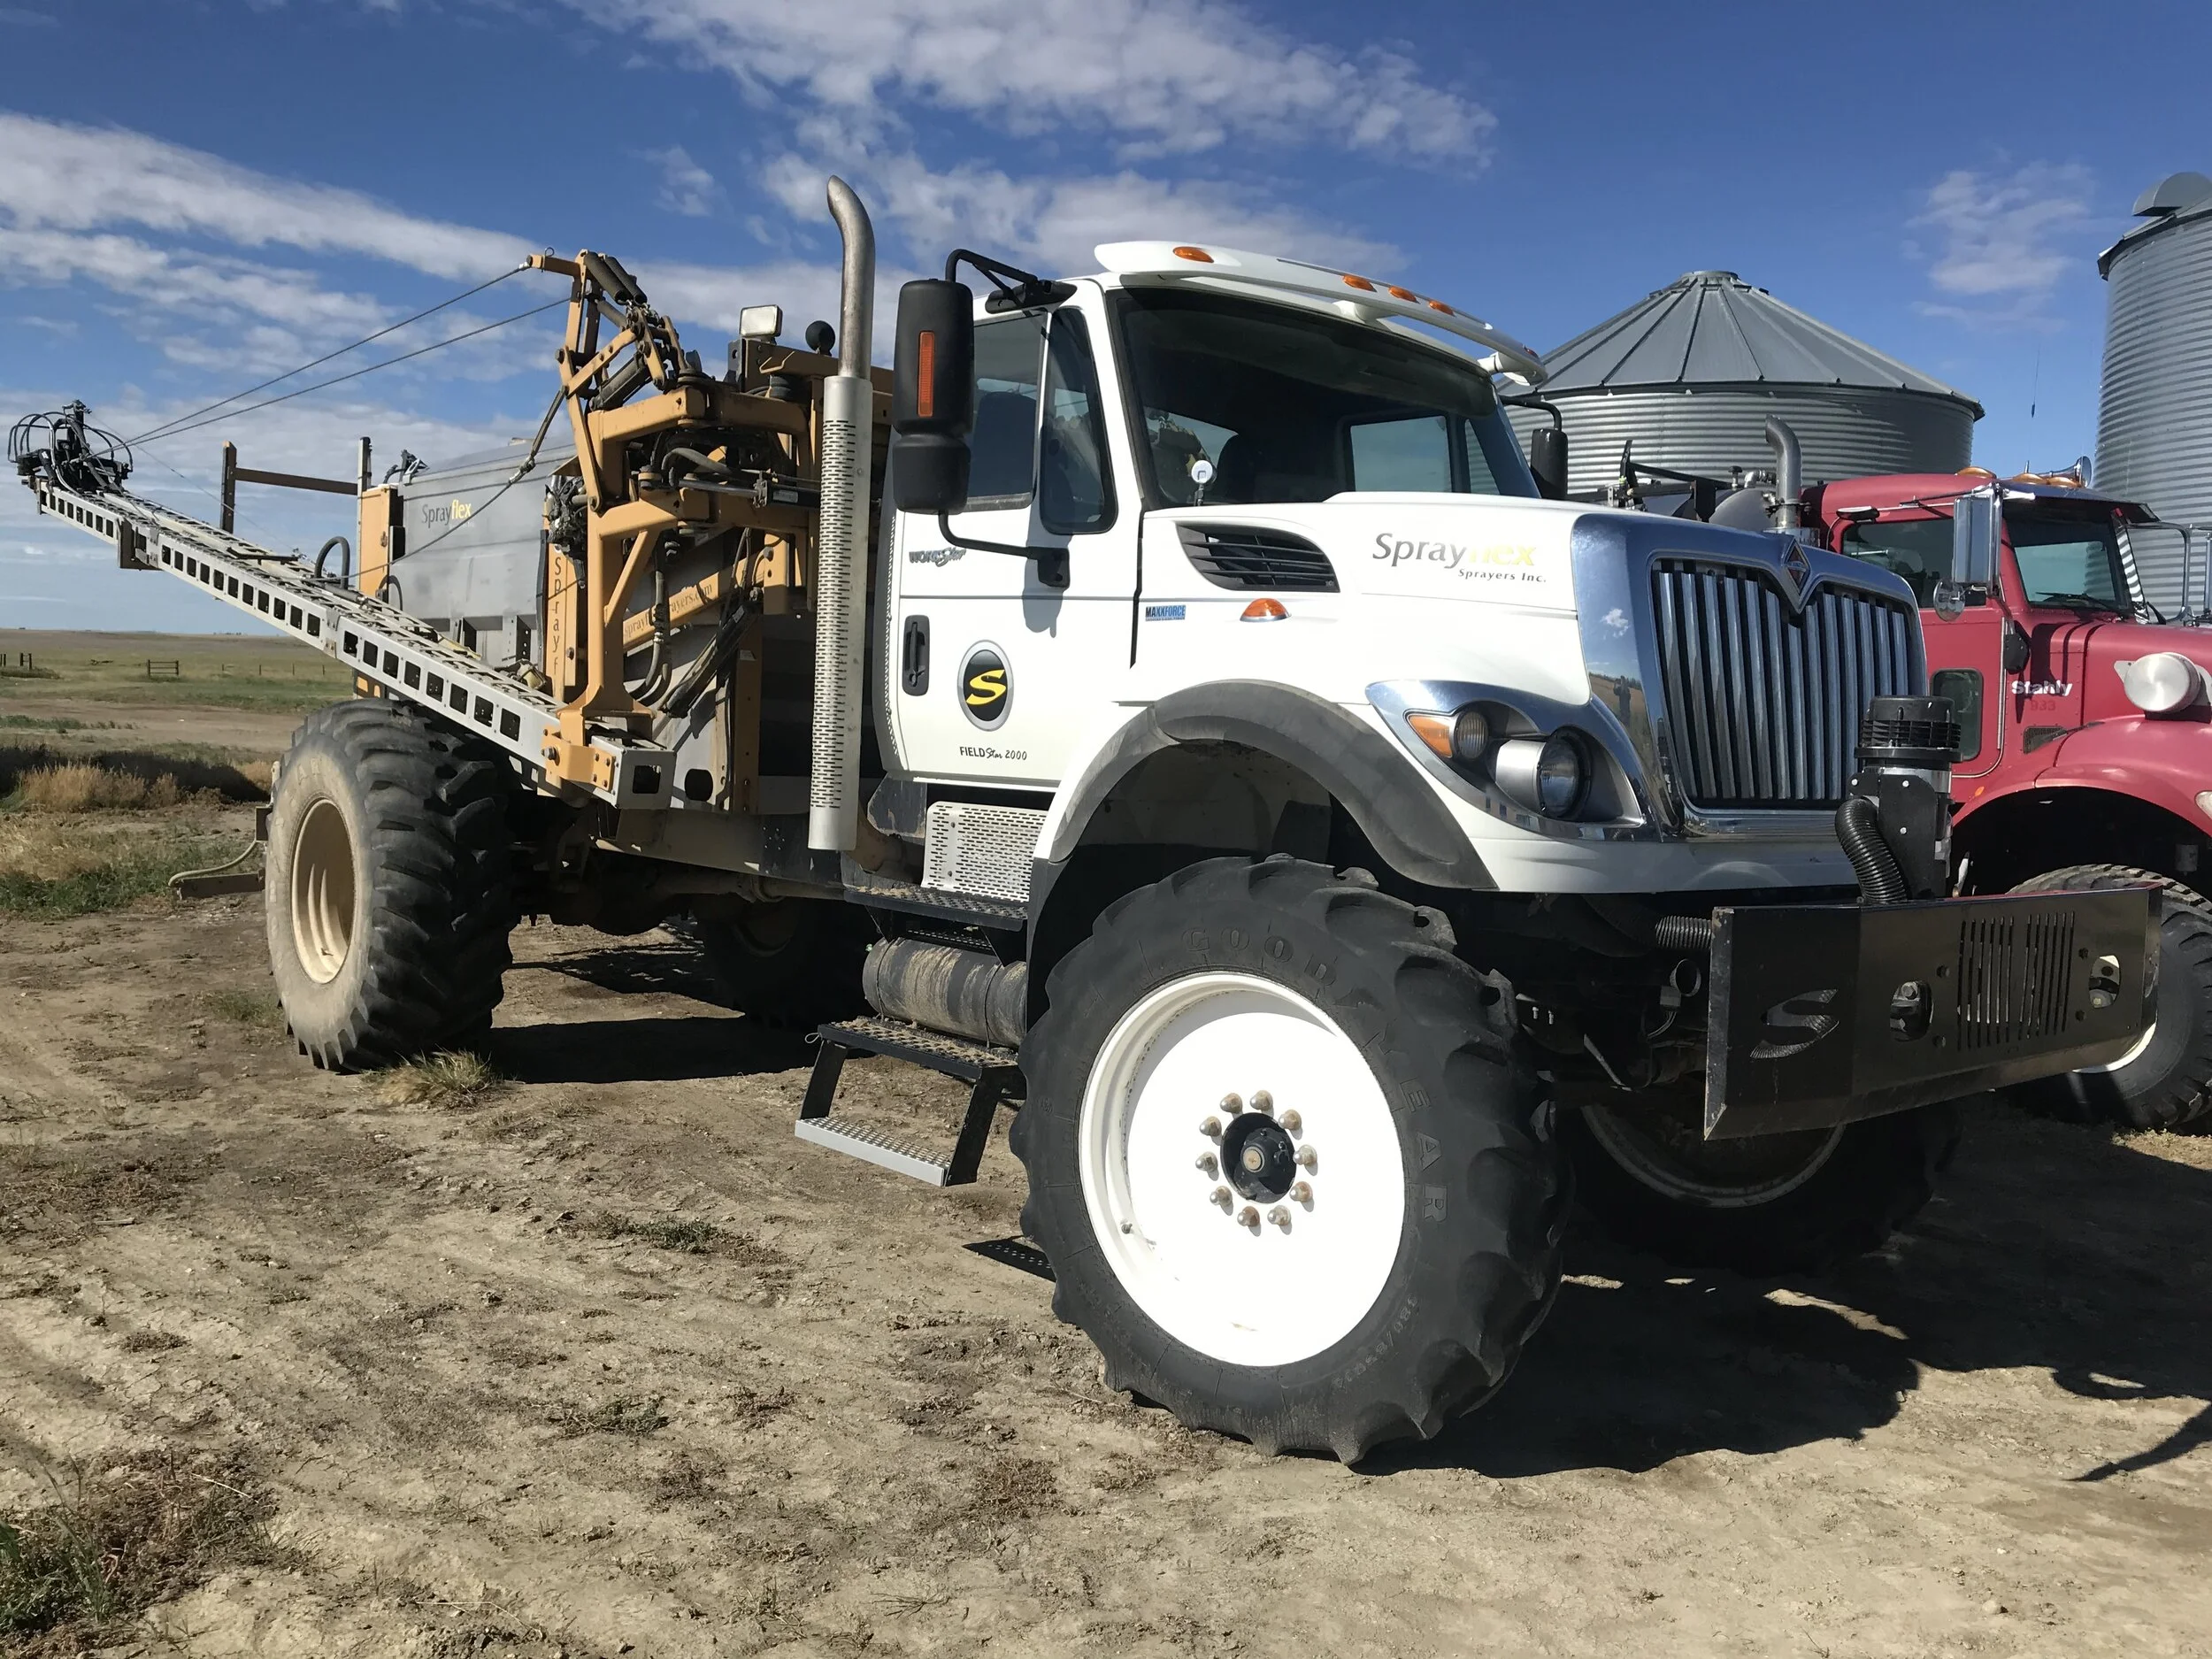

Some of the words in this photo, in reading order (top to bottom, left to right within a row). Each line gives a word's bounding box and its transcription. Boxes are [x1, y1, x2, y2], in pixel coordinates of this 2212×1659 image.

[422, 499, 472, 529] Sprayflex
[1458, 568, 1516, 581] Sprayers
[1521, 572, 1547, 583] Inc.
[1145, 605, 1187, 618] MAXXFORCE
[965, 670, 1006, 705] S
[2011, 680, 2073, 696] Stahly
[1004, 749, 1028, 761] 2000
